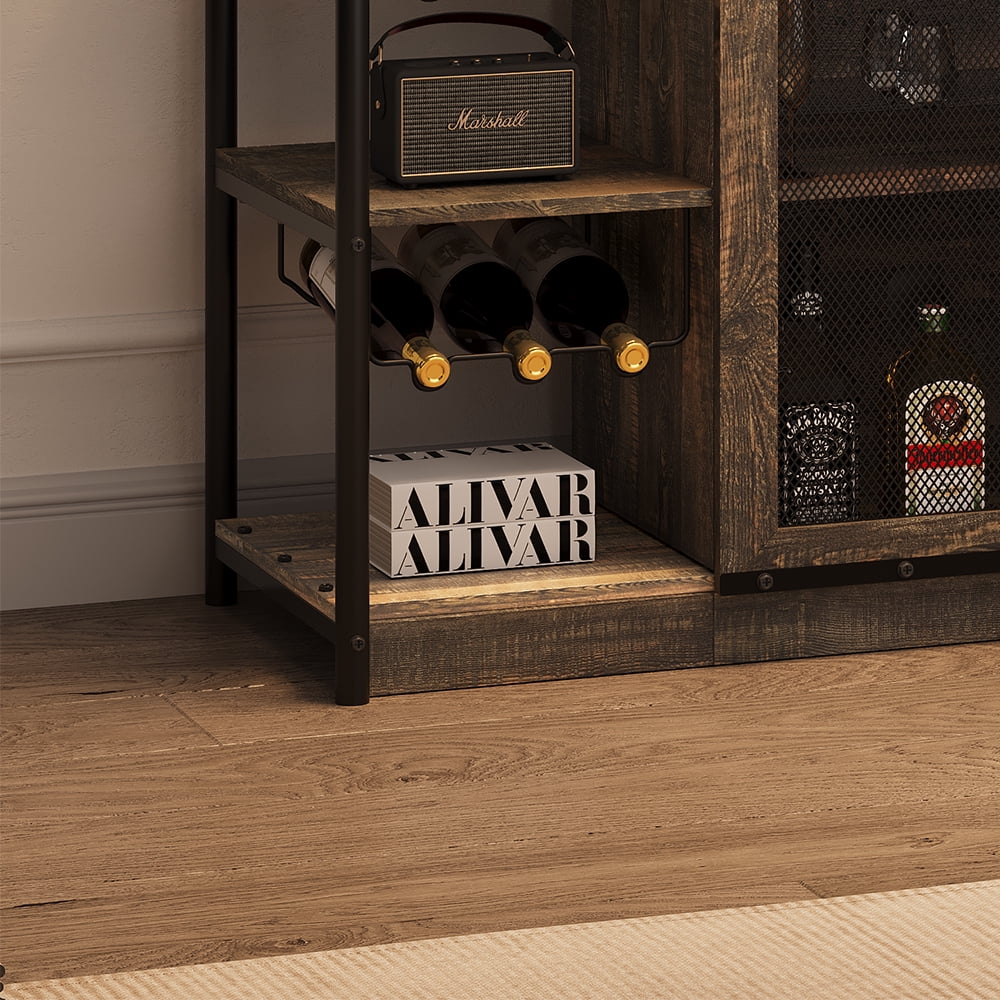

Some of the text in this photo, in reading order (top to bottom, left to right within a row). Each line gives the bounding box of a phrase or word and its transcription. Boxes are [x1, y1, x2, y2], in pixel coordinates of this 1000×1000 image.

[447, 107, 530, 131] Marshall
[393, 472, 593, 530] ALIVAR
[393, 519, 593, 577] ALIVAR
